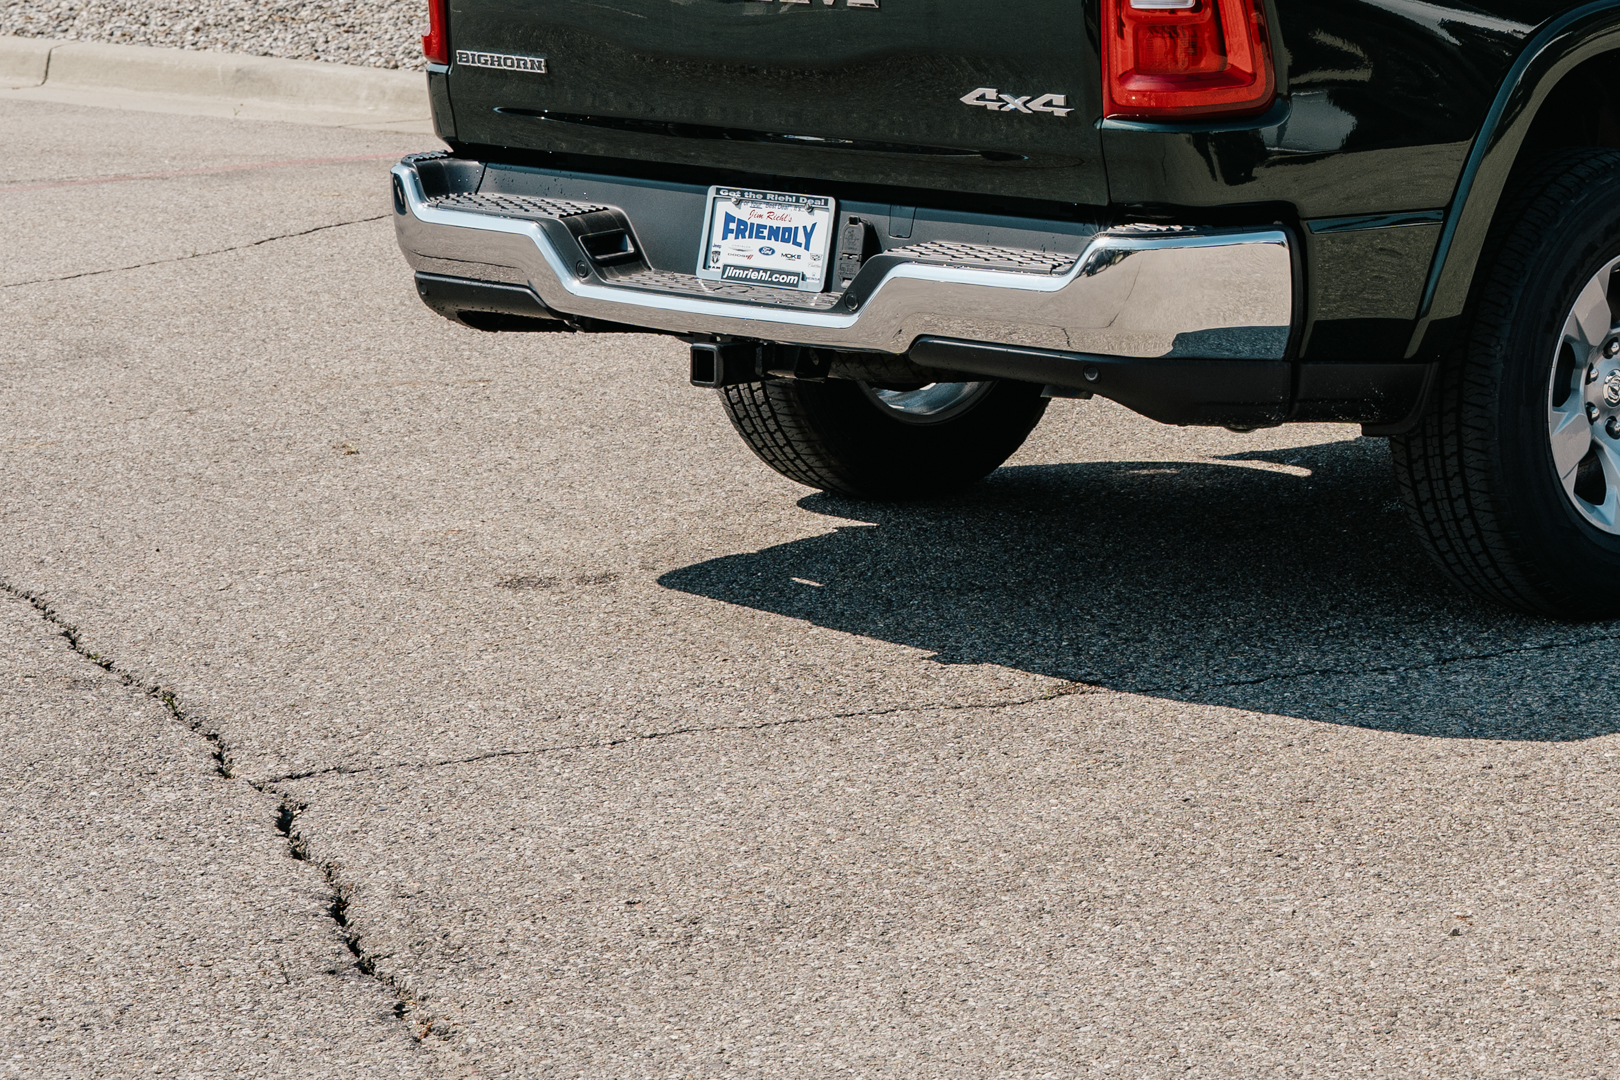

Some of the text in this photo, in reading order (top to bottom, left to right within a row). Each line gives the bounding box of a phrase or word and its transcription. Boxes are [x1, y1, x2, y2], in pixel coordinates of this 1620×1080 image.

[456, 49, 547, 74] BIGHORN
[960, 87, 1075, 117] 4x4
[719, 189, 825, 206] Got the Riehl Deal
[748, 209, 792, 222] Jim Riehl's
[721, 211, 818, 251] FRIENDLY
[722, 267, 799, 284] jimriehl.com
